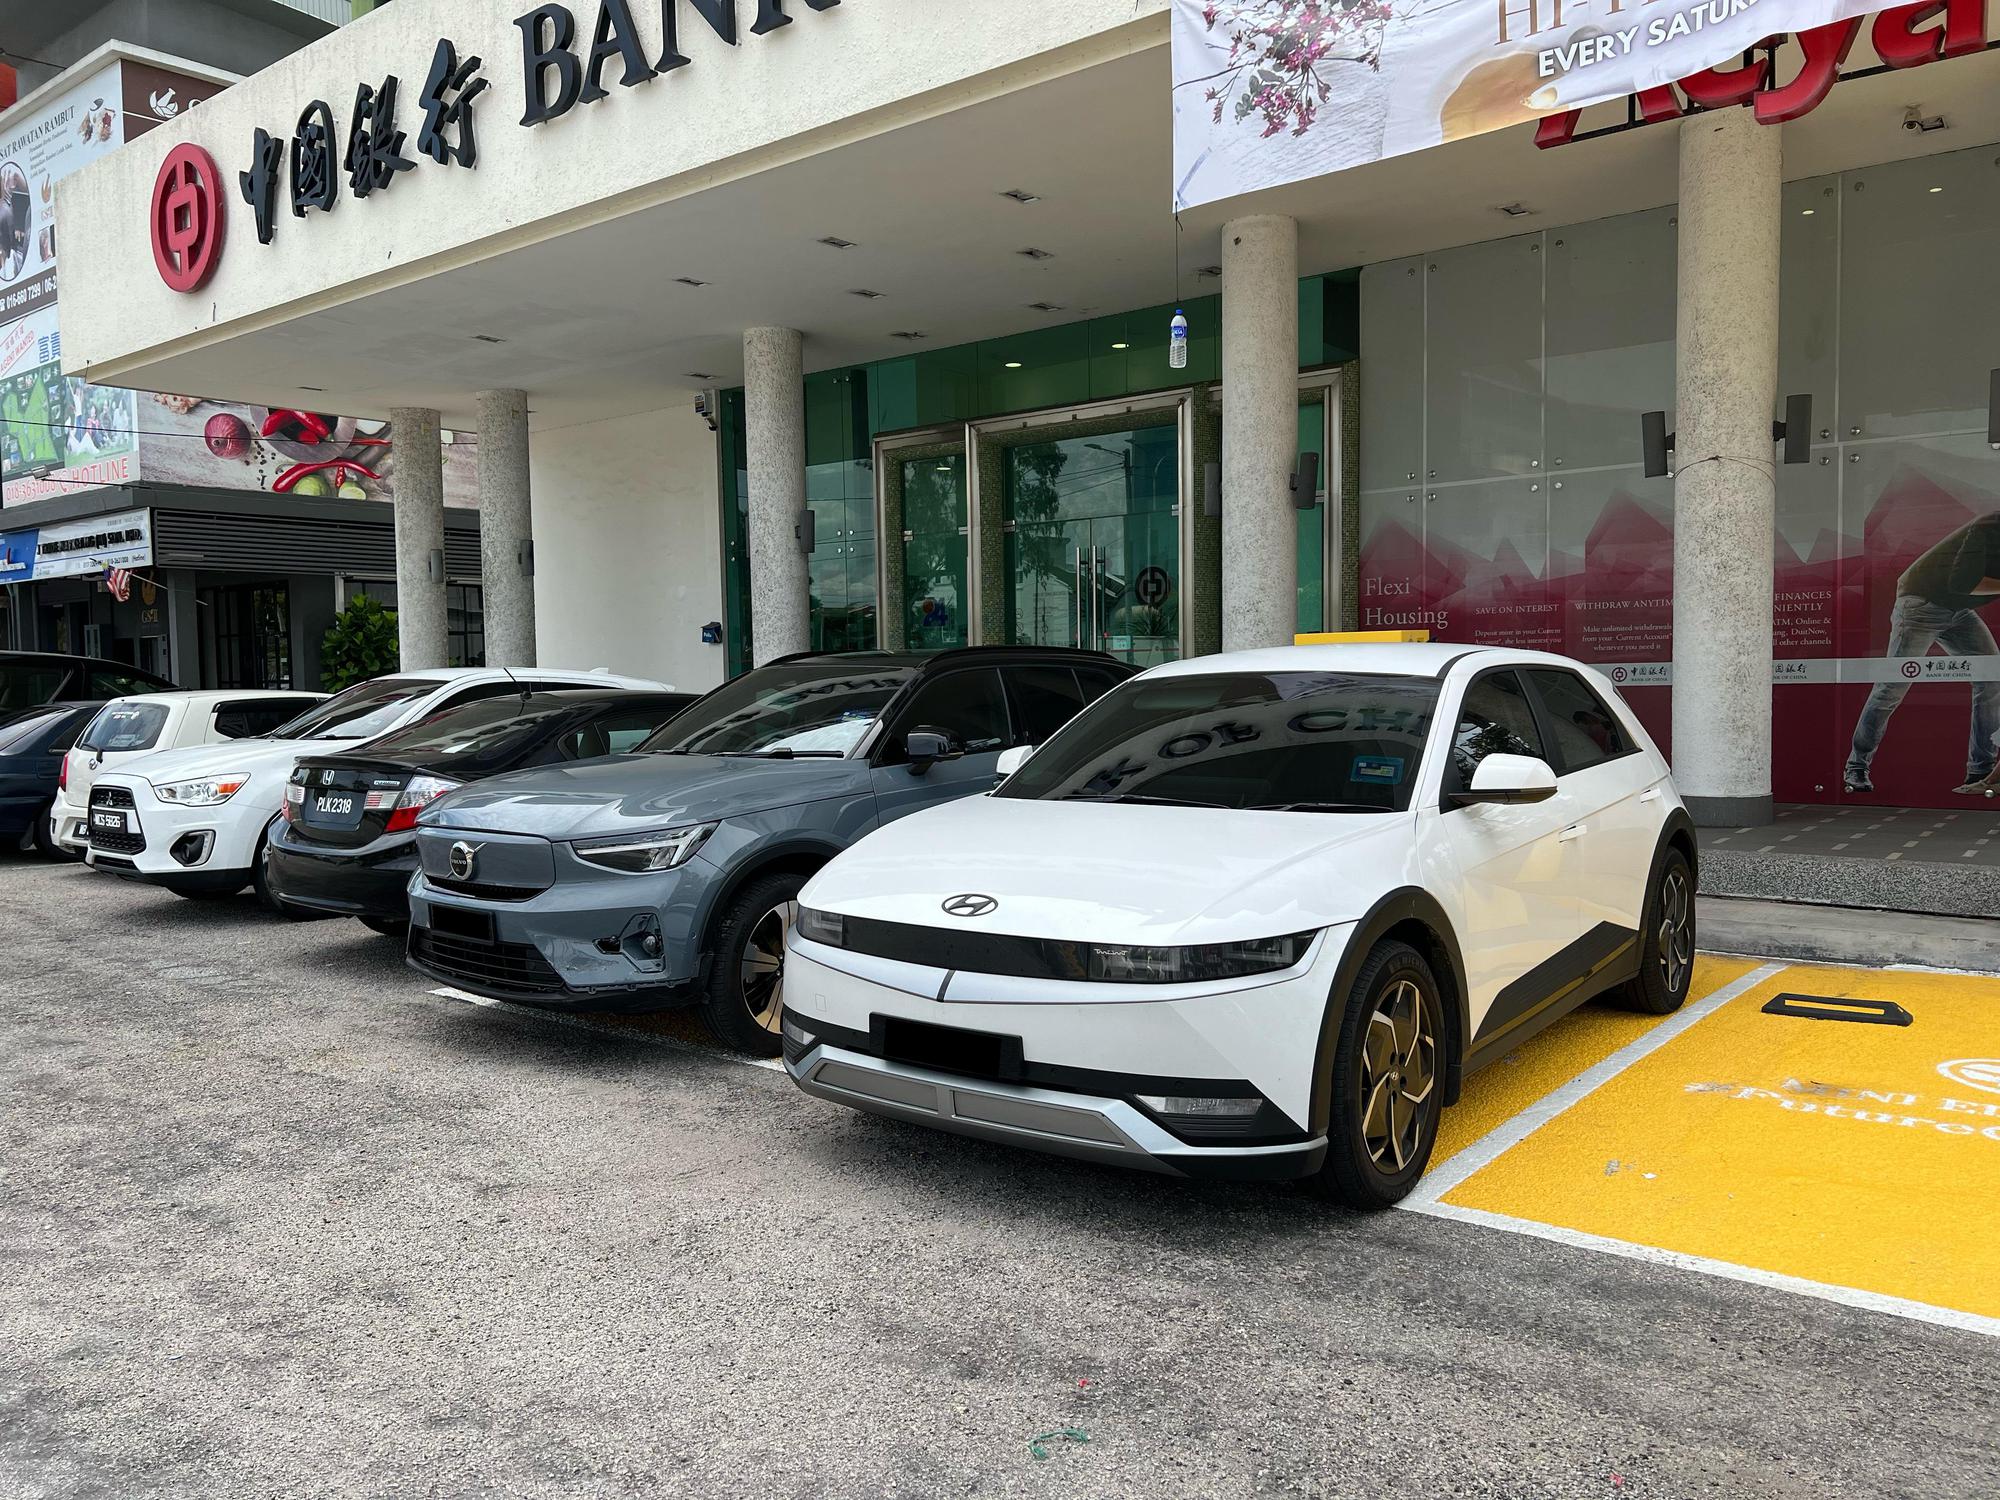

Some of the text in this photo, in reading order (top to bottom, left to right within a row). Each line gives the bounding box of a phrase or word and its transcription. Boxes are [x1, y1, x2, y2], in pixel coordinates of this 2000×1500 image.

[1539, 25, 1640, 78] EVERY
[513, 0, 842, 127] BAN
[12, 125, 44, 154] RAWATAN
[44, 104, 75, 135] RAMBUT
[72, 457, 128, 489] HOTLINE
[1365, 577, 1411, 596] Flexi
[1775, 591, 1832, 601] FINANCES
[1475, 604, 1559, 615] SAVE ON INTEREST
[1574, 601, 1631, 610] WITHDRAW
[1365, 606, 1449, 630] Housing
[1795, 617, 1820, 625] Online
[1602, 624, 1632, 632] unlimited
[1616, 633, 1641, 641] Current
[1779, 638, 1798, 646] other
[1800, 637, 1832, 645] channels
[1639, 642, 1655, 650] need
[316, 797, 352, 813] PLK2318
